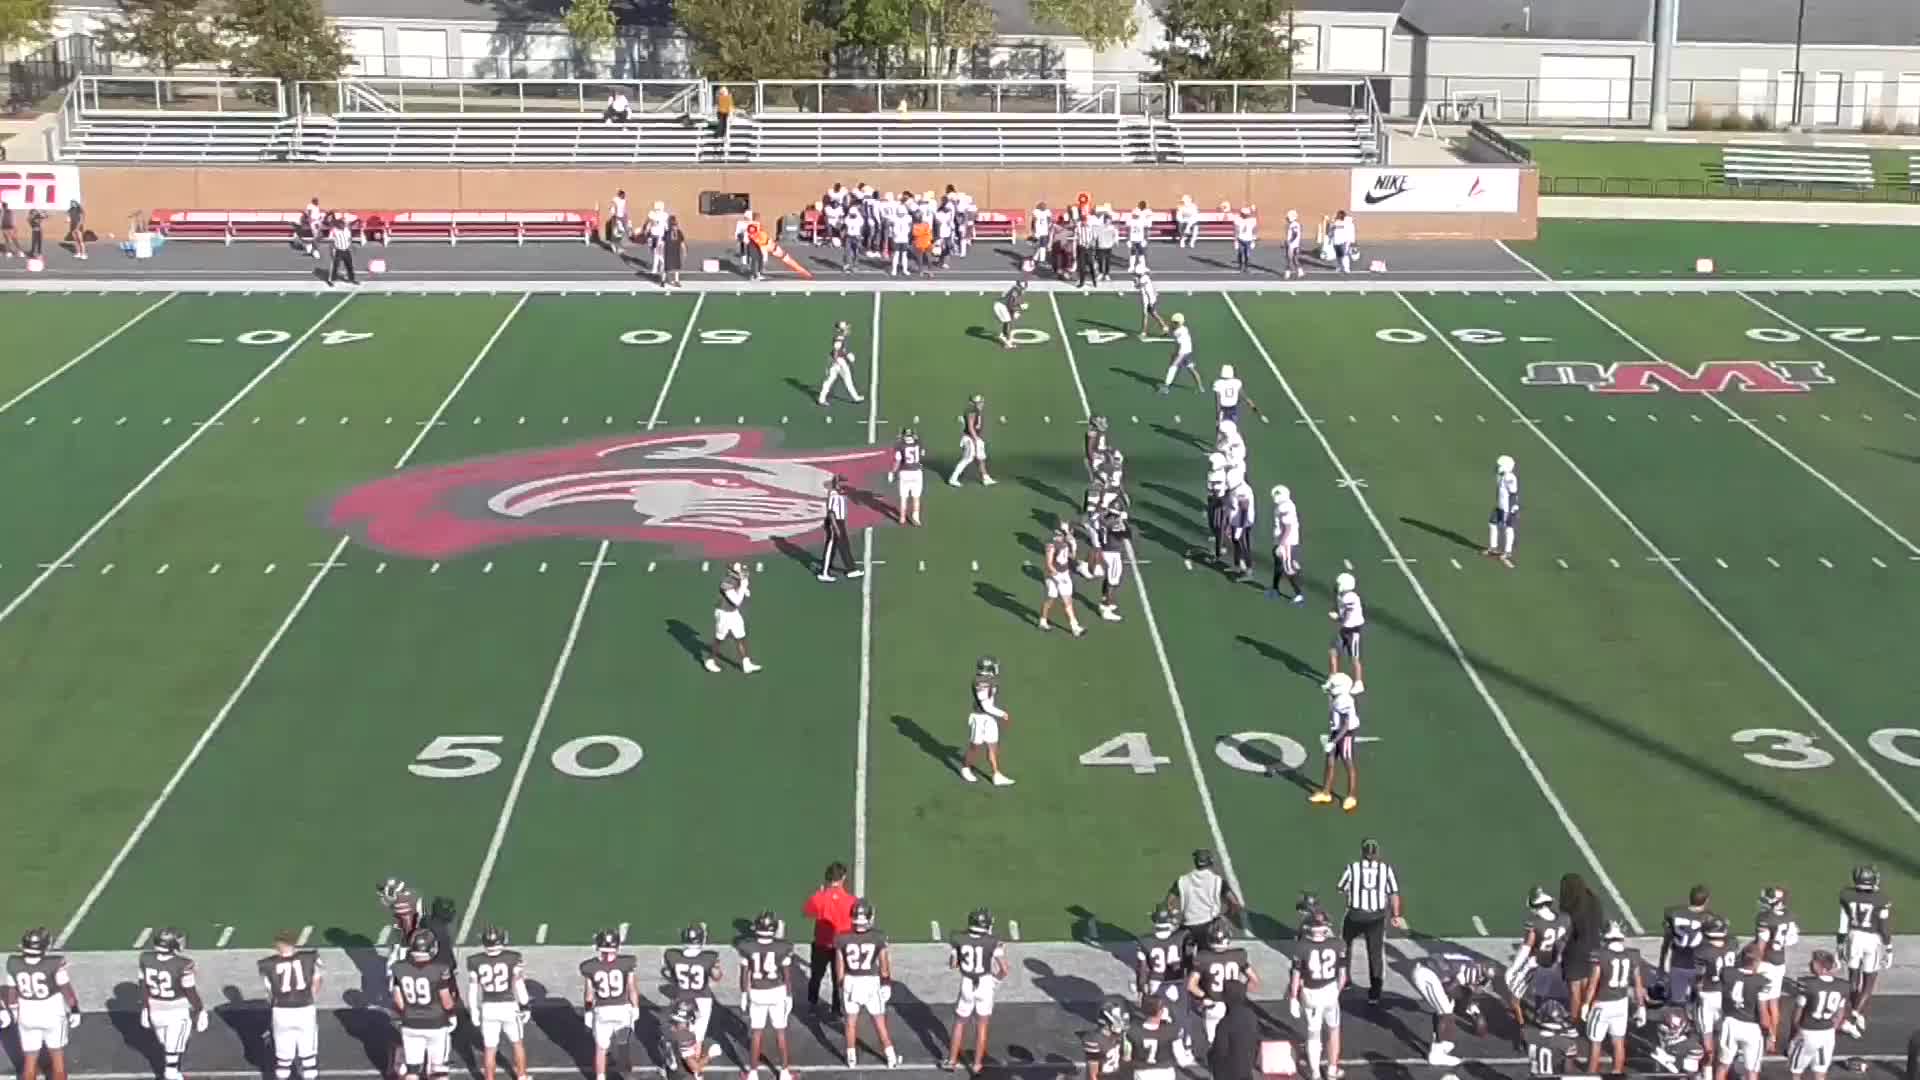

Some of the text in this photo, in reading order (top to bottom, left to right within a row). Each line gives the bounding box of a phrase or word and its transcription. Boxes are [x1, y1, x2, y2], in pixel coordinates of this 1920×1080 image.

[1374, 175, 1408, 191] NIKE
[904, 445, 919, 464] 51
[407, 735, 643, 778] 50
[1079, 732, 1308, 773] 40
[1850, 901, 1874, 928] 17
[751, 952, 778, 980] 14
[846, 943, 876, 970] 27
[960, 945, 985, 974] 31
[1308, 949, 1336, 980] 42
[145, 967, 175, 997] 52
[275, 960, 307, 993] 71
[479, 962, 509, 993] 22
[593, 969, 624, 998] 39
[674, 964, 705, 990] 53
[1609, 958, 1631, 988] 11
[401, 976, 432, 1006] 89
[1143, 1039, 1158, 1064] 7
